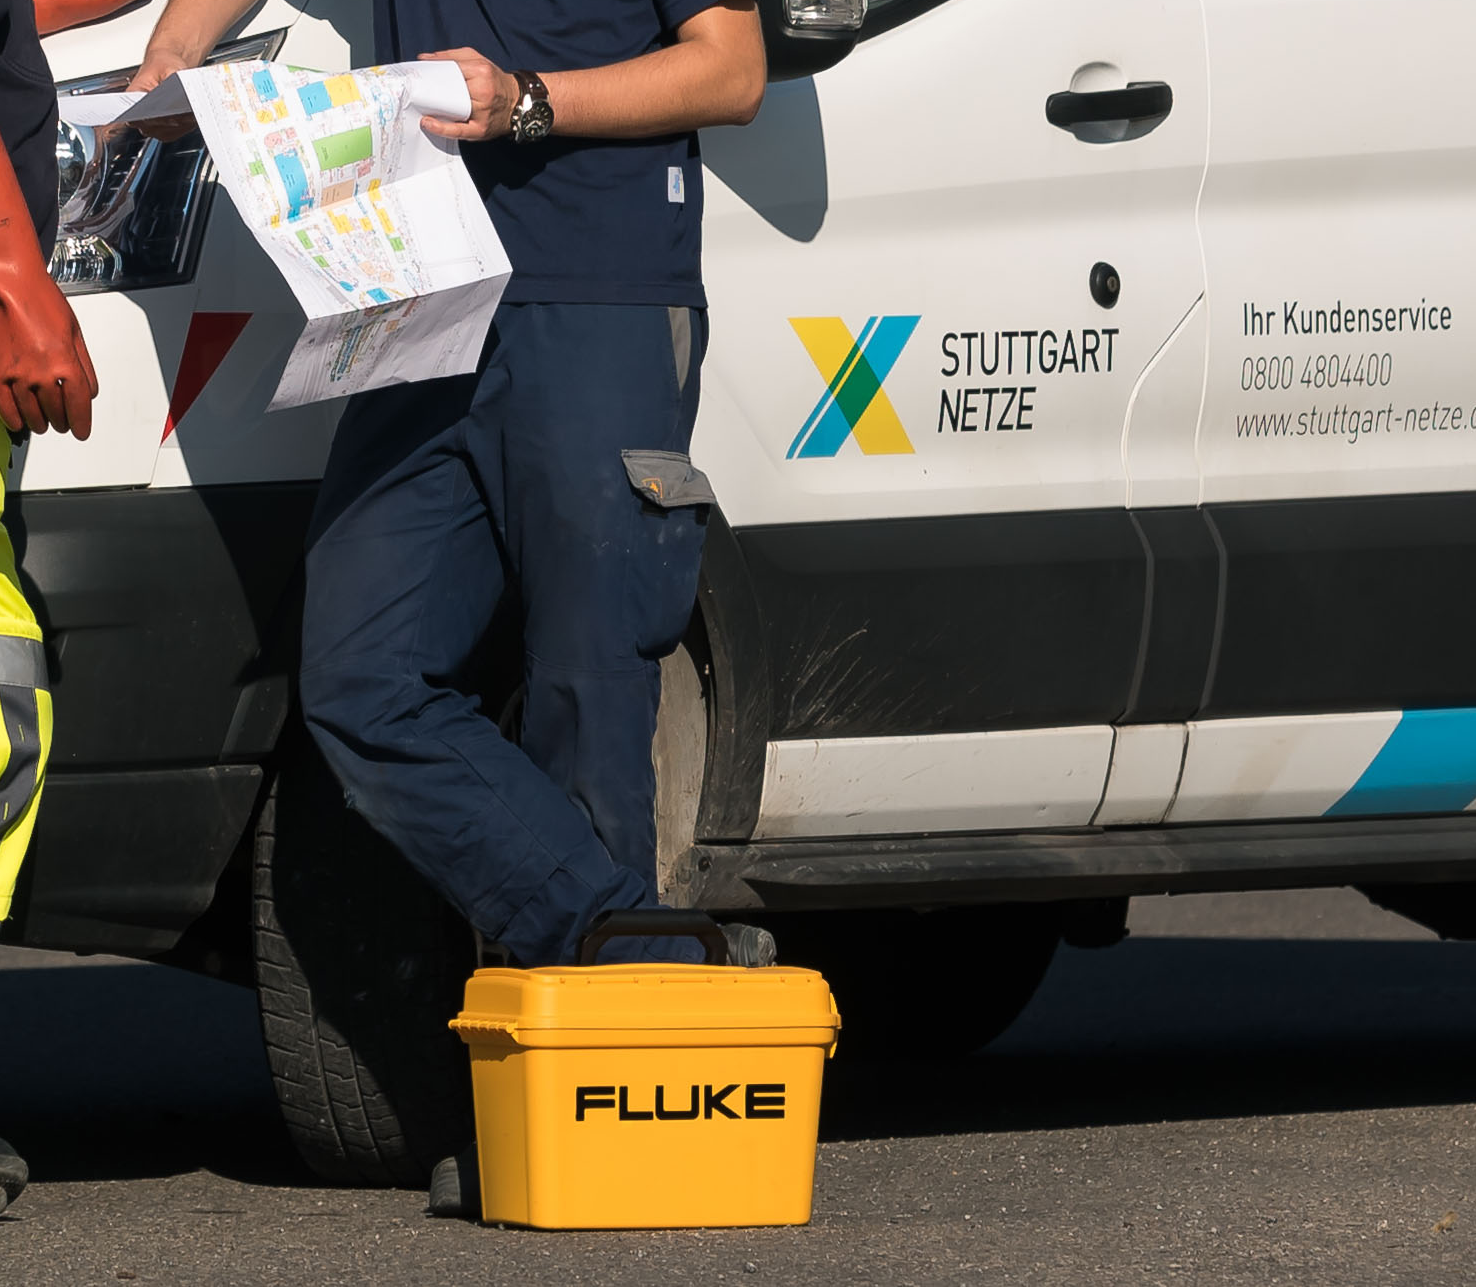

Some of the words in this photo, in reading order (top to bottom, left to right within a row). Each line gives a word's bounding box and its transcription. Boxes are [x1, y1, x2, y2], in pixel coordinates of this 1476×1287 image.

[1243, 302, 1276, 336] Ihr
[1283, 298, 1453, 335] Kundenservice
[940, 328, 1119, 378] STUTTGART
[1241, 355, 1294, 392] 0800
[1300, 352, 1392, 390] 4804400
[937, 386, 1037, 433] NETZE
[575, 1083, 786, 1122] FLUKE
